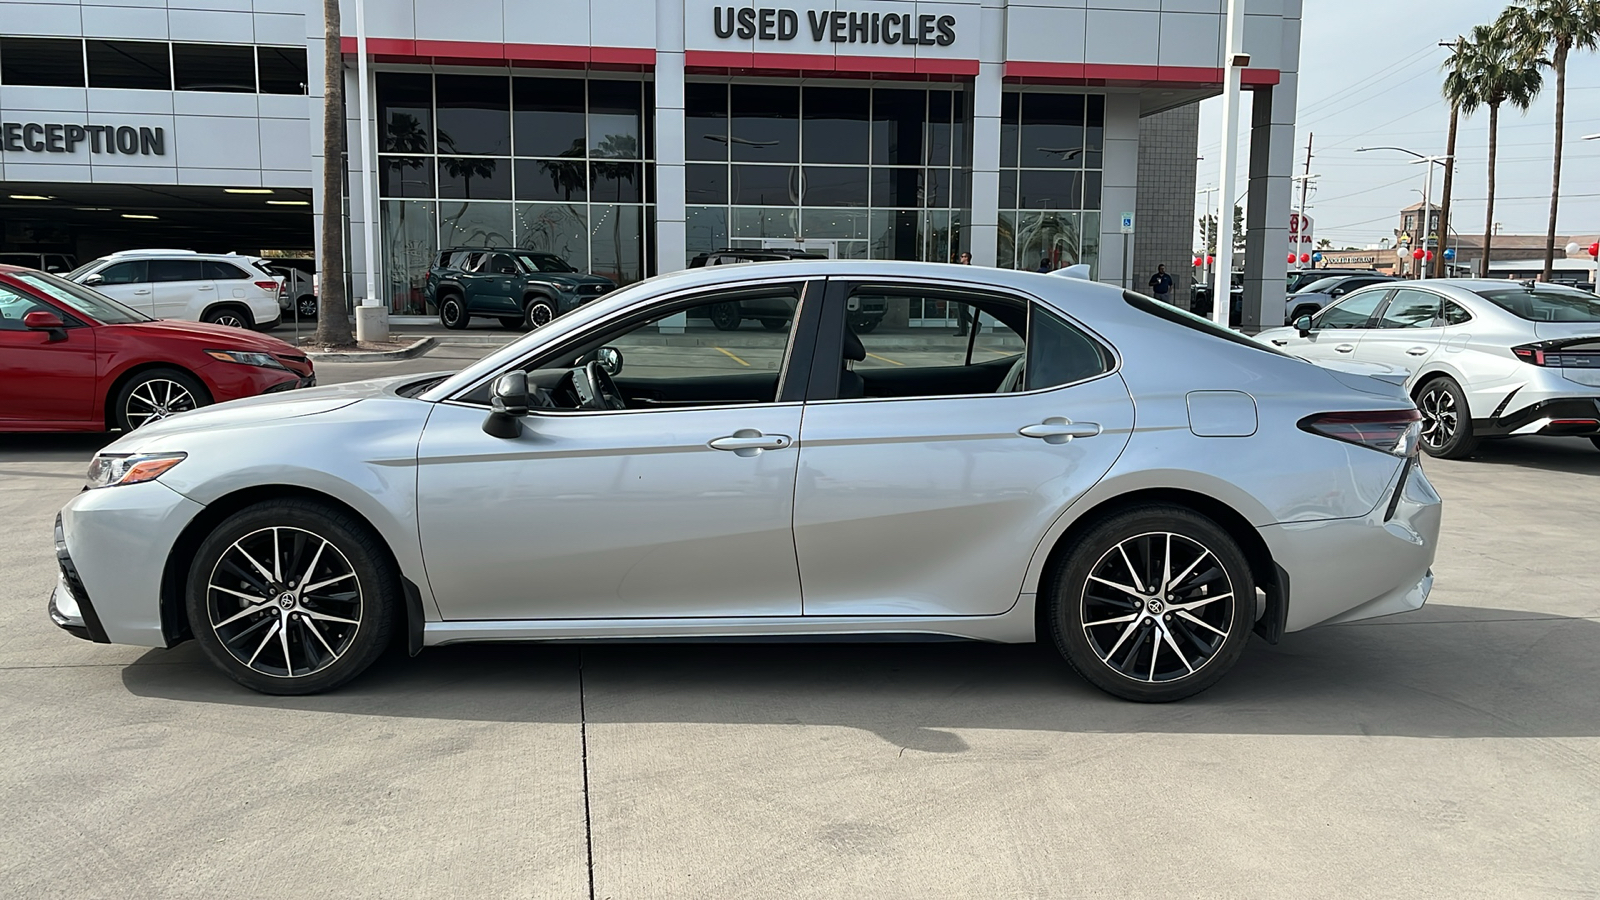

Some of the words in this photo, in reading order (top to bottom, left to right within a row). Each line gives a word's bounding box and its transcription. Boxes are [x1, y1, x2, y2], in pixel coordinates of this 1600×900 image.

[714, 6, 799, 41] USED
[807, 10, 956, 46] VEHICLES
[0, 122, 165, 156] ECEPTION
[1288, 235, 1312, 244] YOTA
